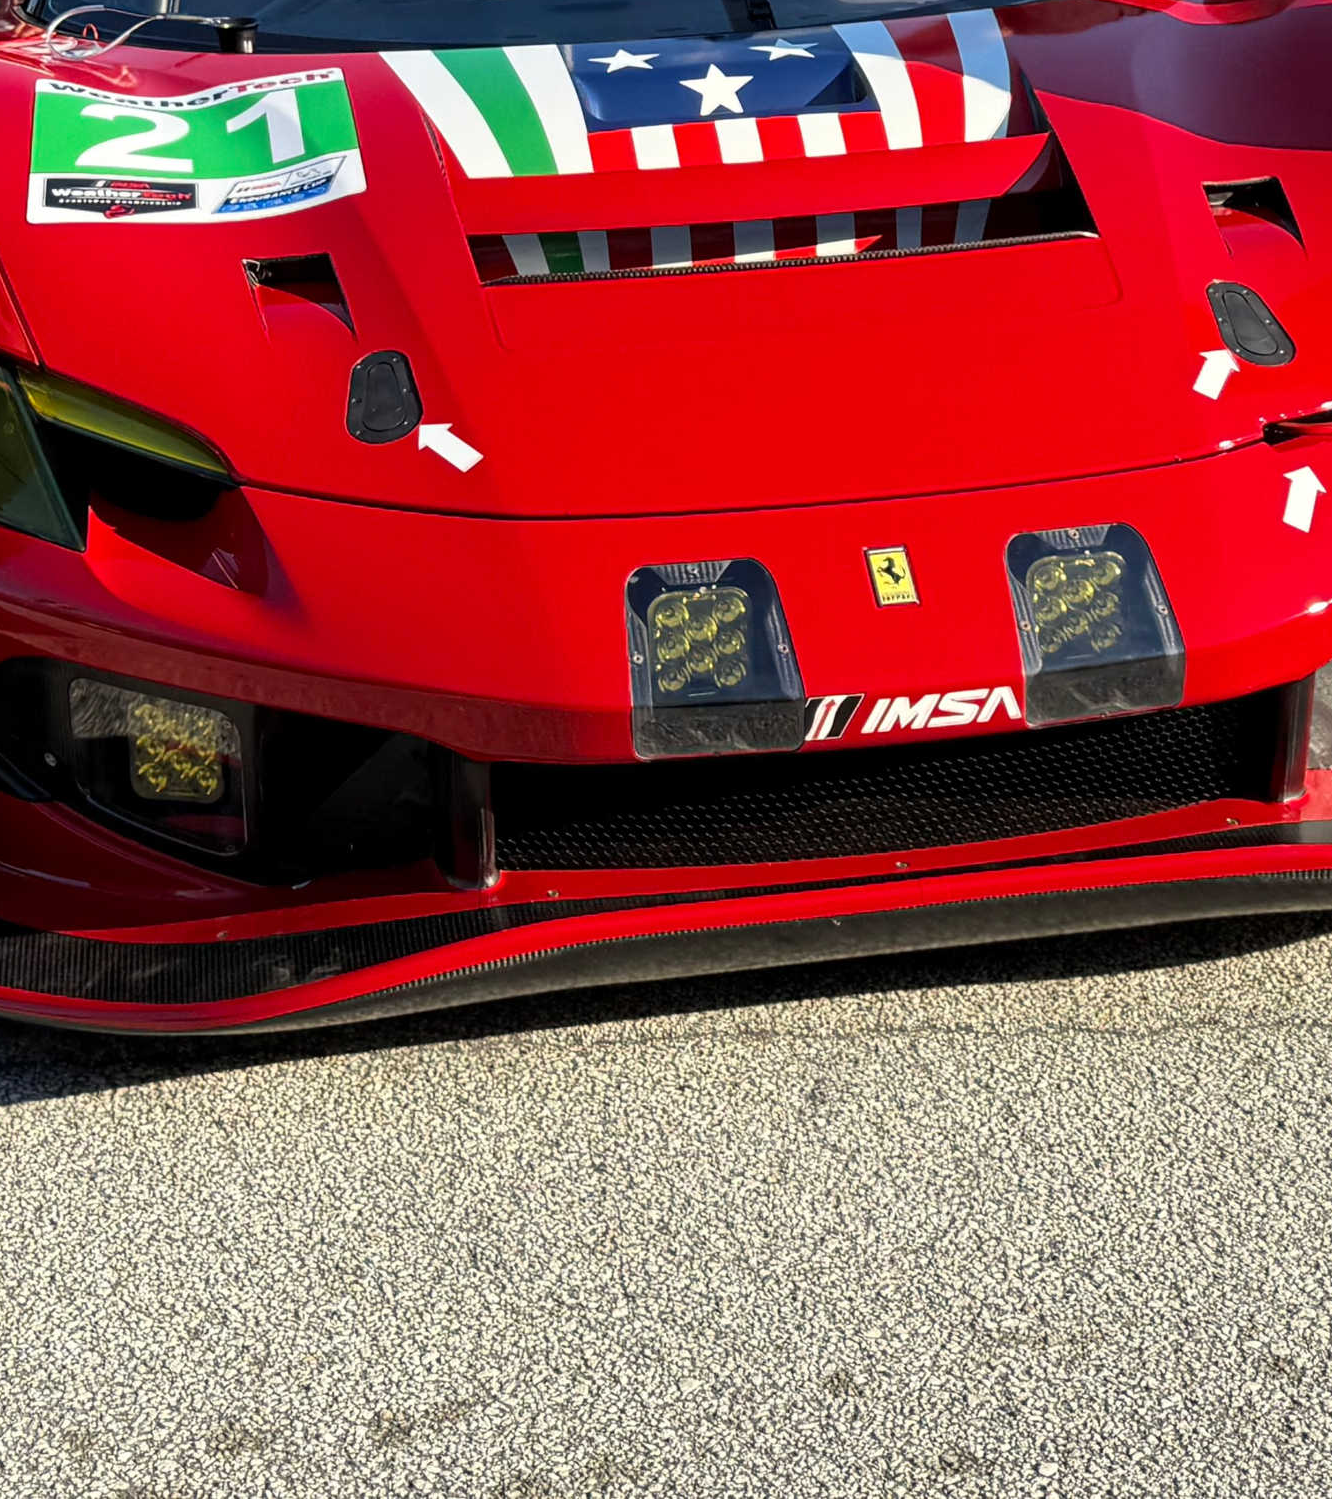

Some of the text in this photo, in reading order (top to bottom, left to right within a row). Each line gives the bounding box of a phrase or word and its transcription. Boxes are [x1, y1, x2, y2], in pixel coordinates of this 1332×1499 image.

[49, 70, 336, 109] WeatherTech
[75, 89, 306, 173] 21
[860, 685, 1022, 735] IMSA
